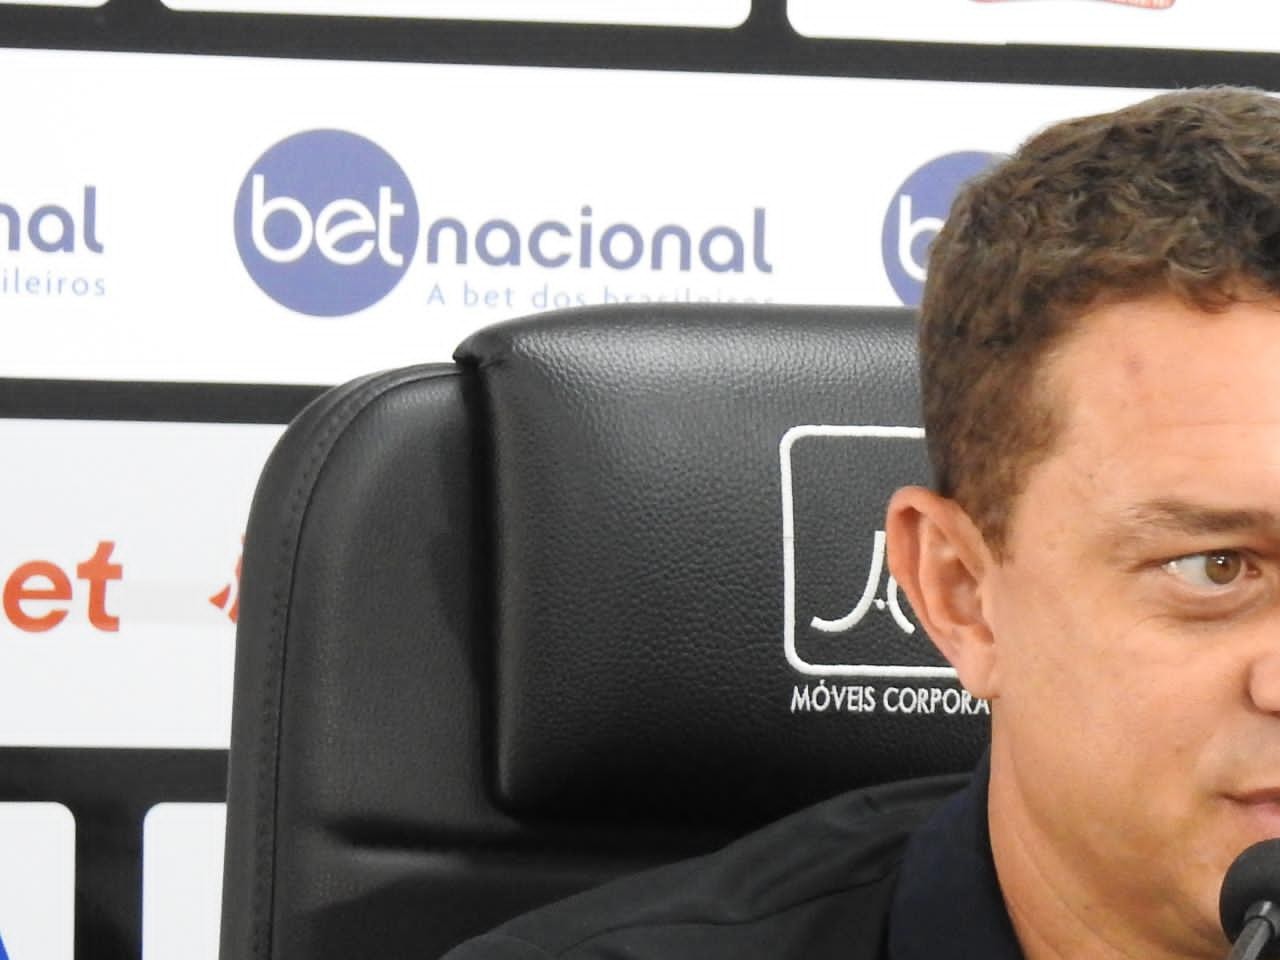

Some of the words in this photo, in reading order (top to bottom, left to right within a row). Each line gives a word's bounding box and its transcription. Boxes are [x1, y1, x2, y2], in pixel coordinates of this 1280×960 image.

[251, 173, 405, 267] bet
[426, 204, 773, 274] nacional
[426, 280, 447, 306] A
[463, 280, 516, 309] bet
[531, 281, 586, 309] dos
[790, 679, 876, 713] MÓVEIS
[883, 687, 990, 715] CORPORA
